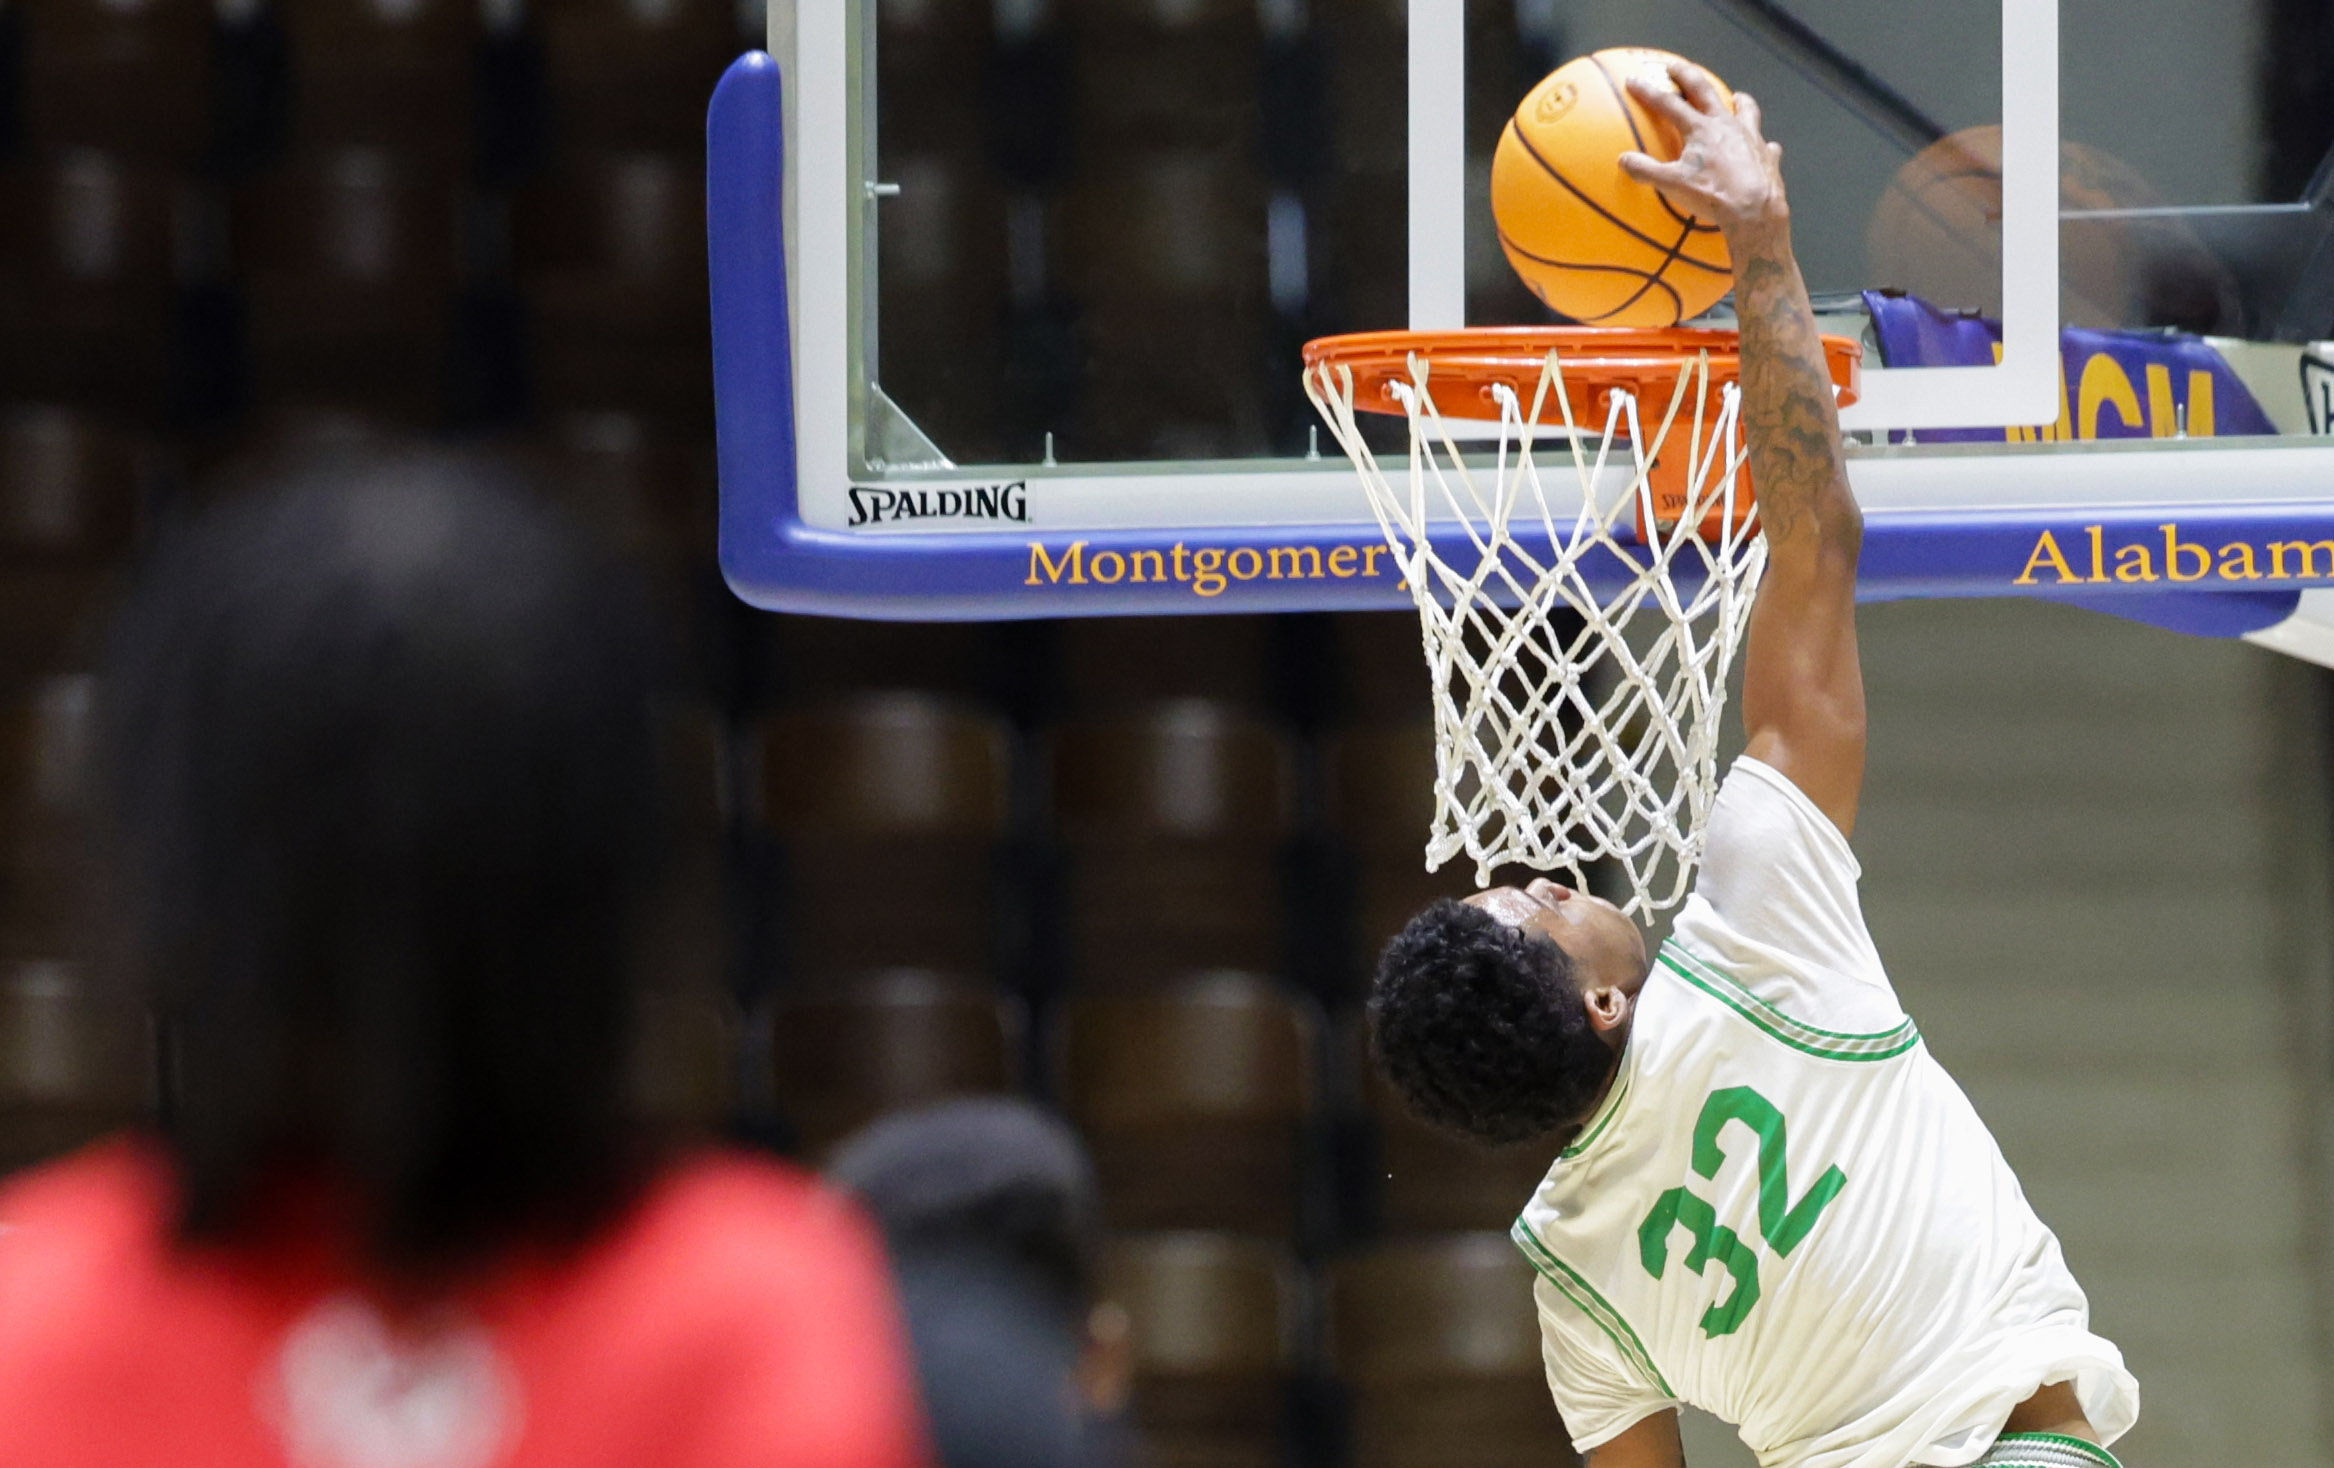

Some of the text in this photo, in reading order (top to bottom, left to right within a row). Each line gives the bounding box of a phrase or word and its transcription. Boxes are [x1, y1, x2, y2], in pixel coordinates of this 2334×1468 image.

[848, 480, 1027, 528] SPALDING
[1025, 540, 1409, 597] Montgomer
[1637, 1085, 1847, 1340] 32
